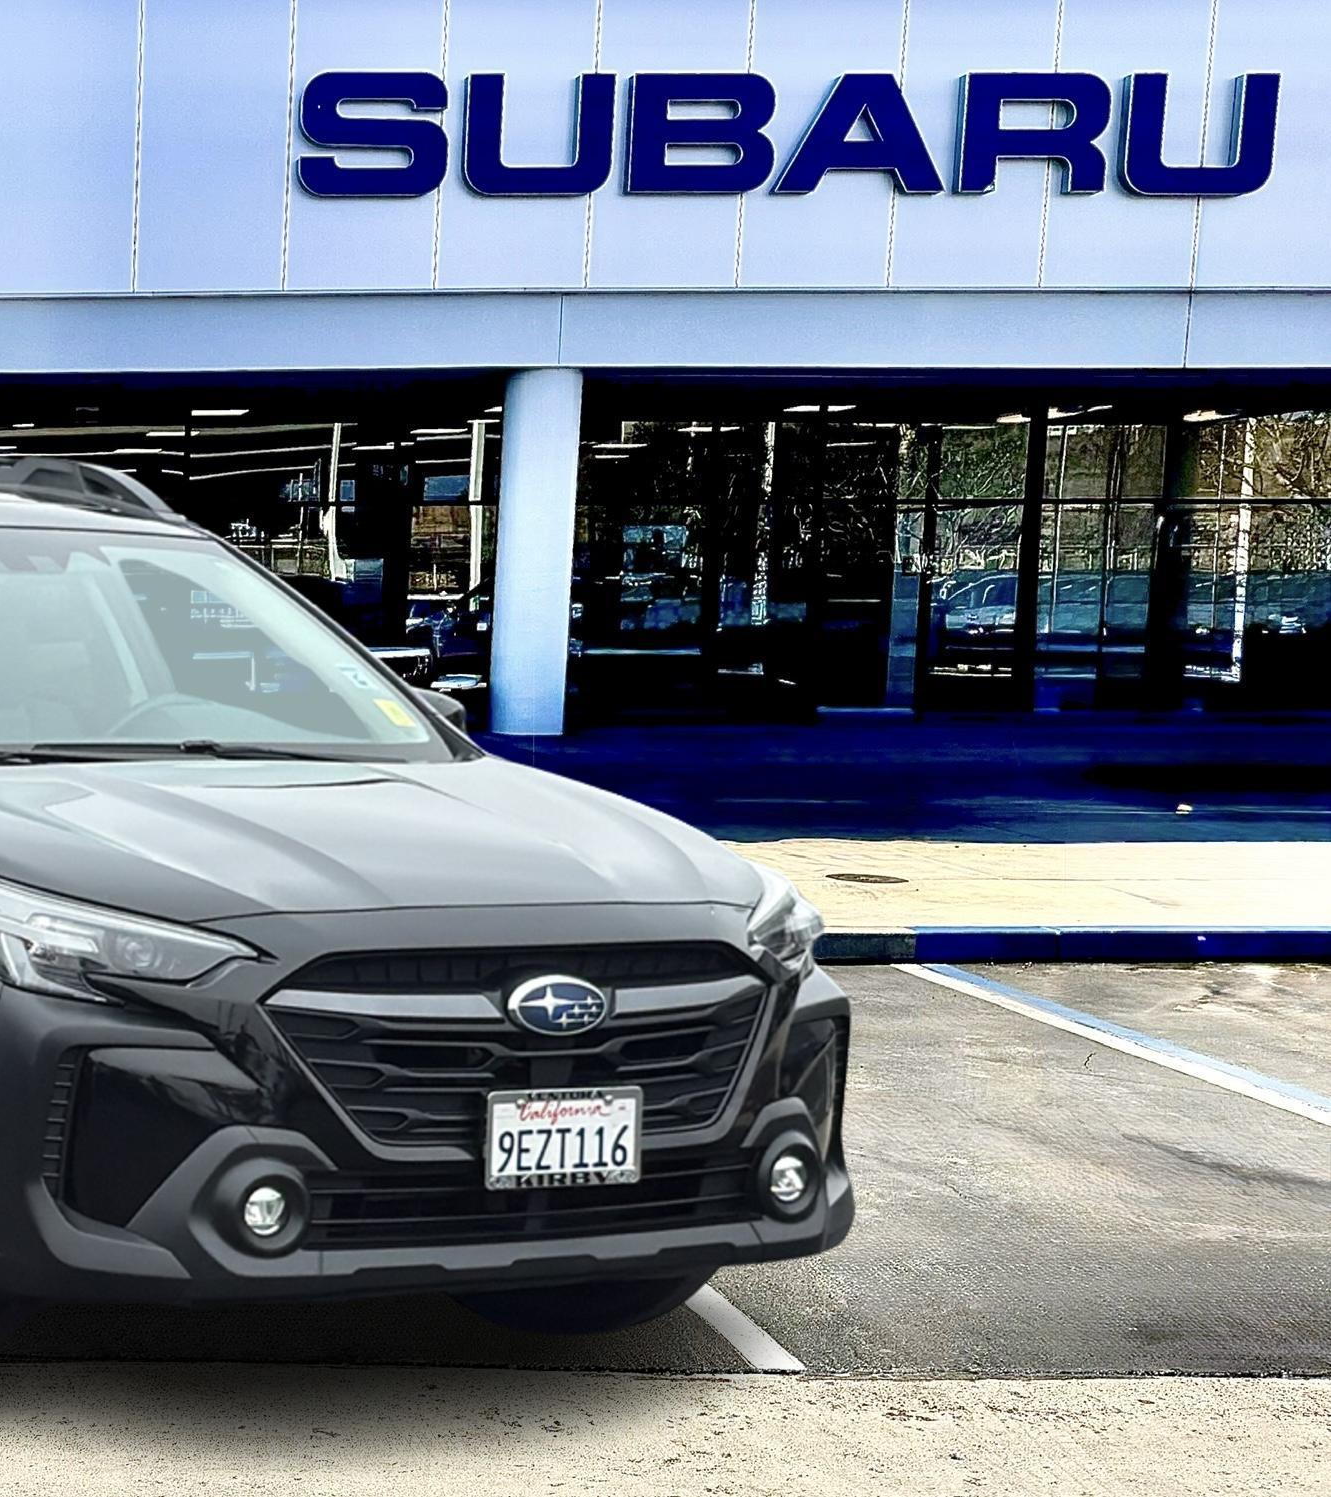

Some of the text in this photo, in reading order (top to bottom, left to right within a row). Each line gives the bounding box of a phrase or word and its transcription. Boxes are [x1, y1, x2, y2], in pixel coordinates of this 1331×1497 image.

[297, 70, 1280, 197] SUBARU
[527, 1090, 605, 1101] VENTURA
[519, 1101, 611, 1125] California
[498, 1125, 628, 1173] 9EZT116
[518, 1171, 610, 1187] KIRBY
